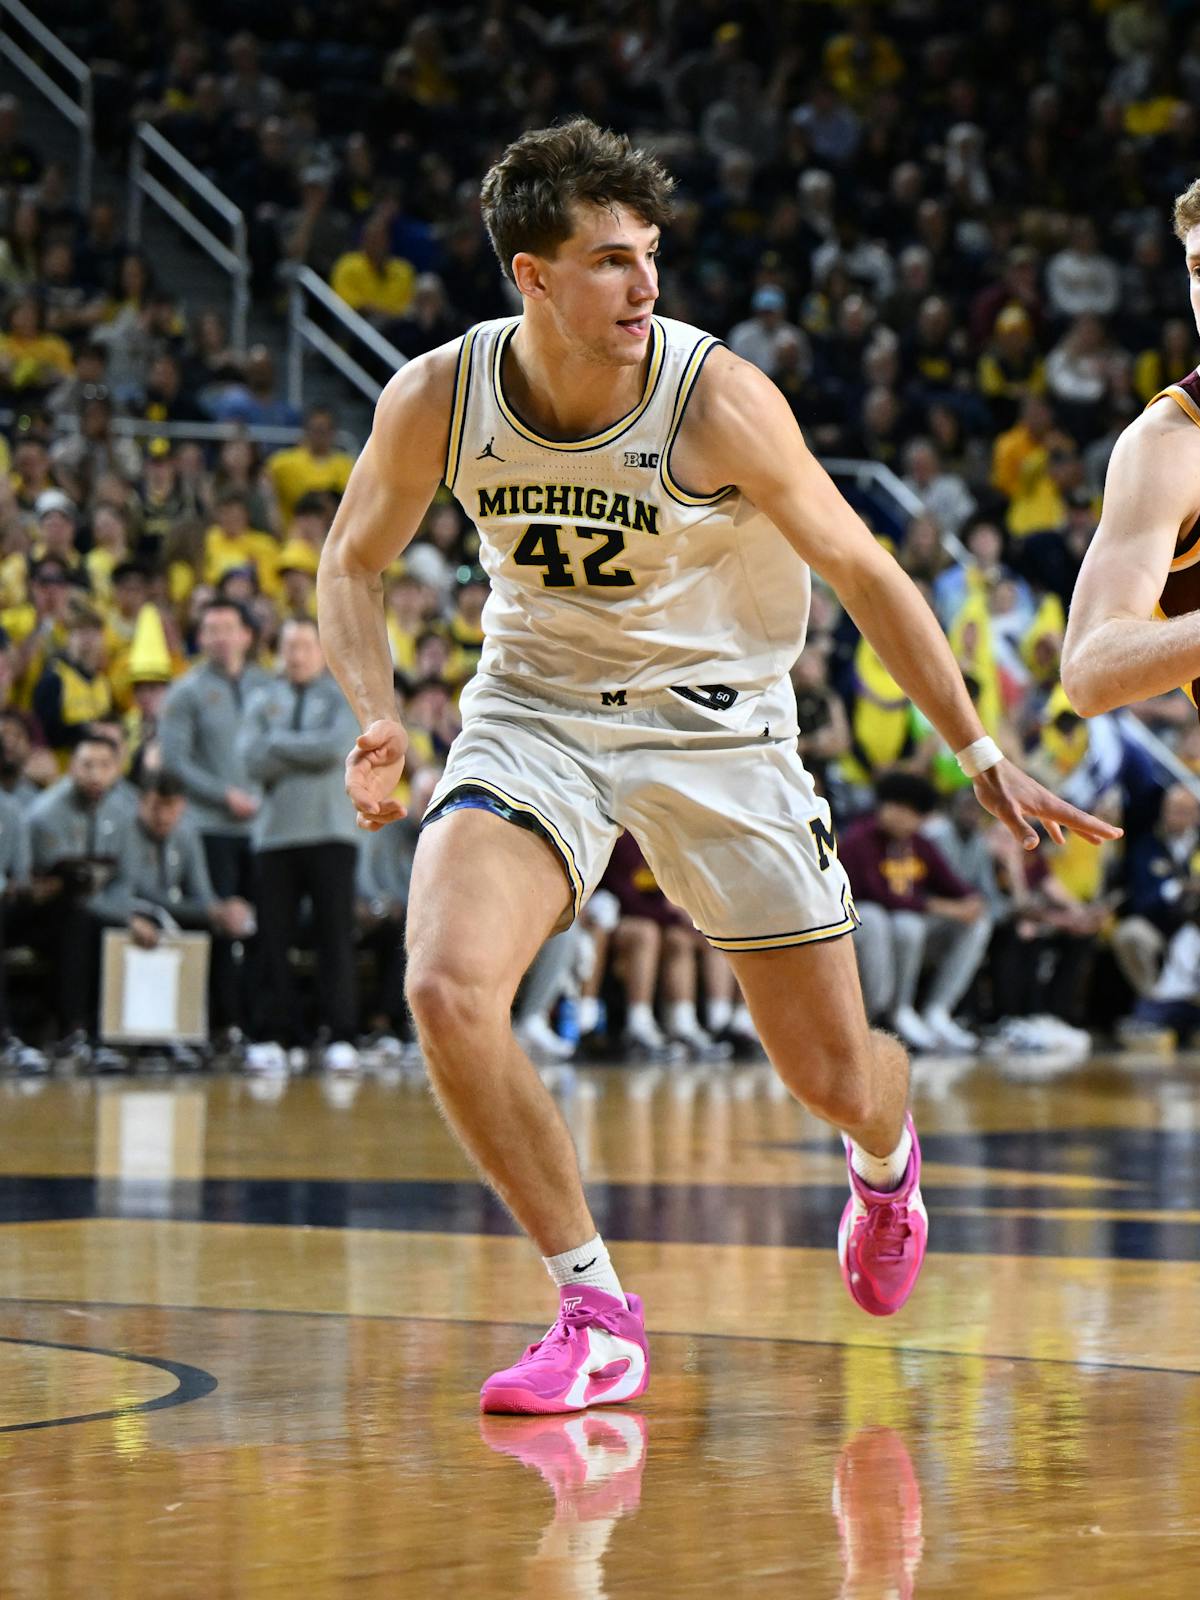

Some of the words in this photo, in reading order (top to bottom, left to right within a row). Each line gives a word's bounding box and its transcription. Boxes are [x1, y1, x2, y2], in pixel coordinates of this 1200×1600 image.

[478, 485, 659, 536] MICHIGAN
[513, 523, 636, 587] 42
[600, 690, 628, 707] M
[715, 691, 731, 703] 50
